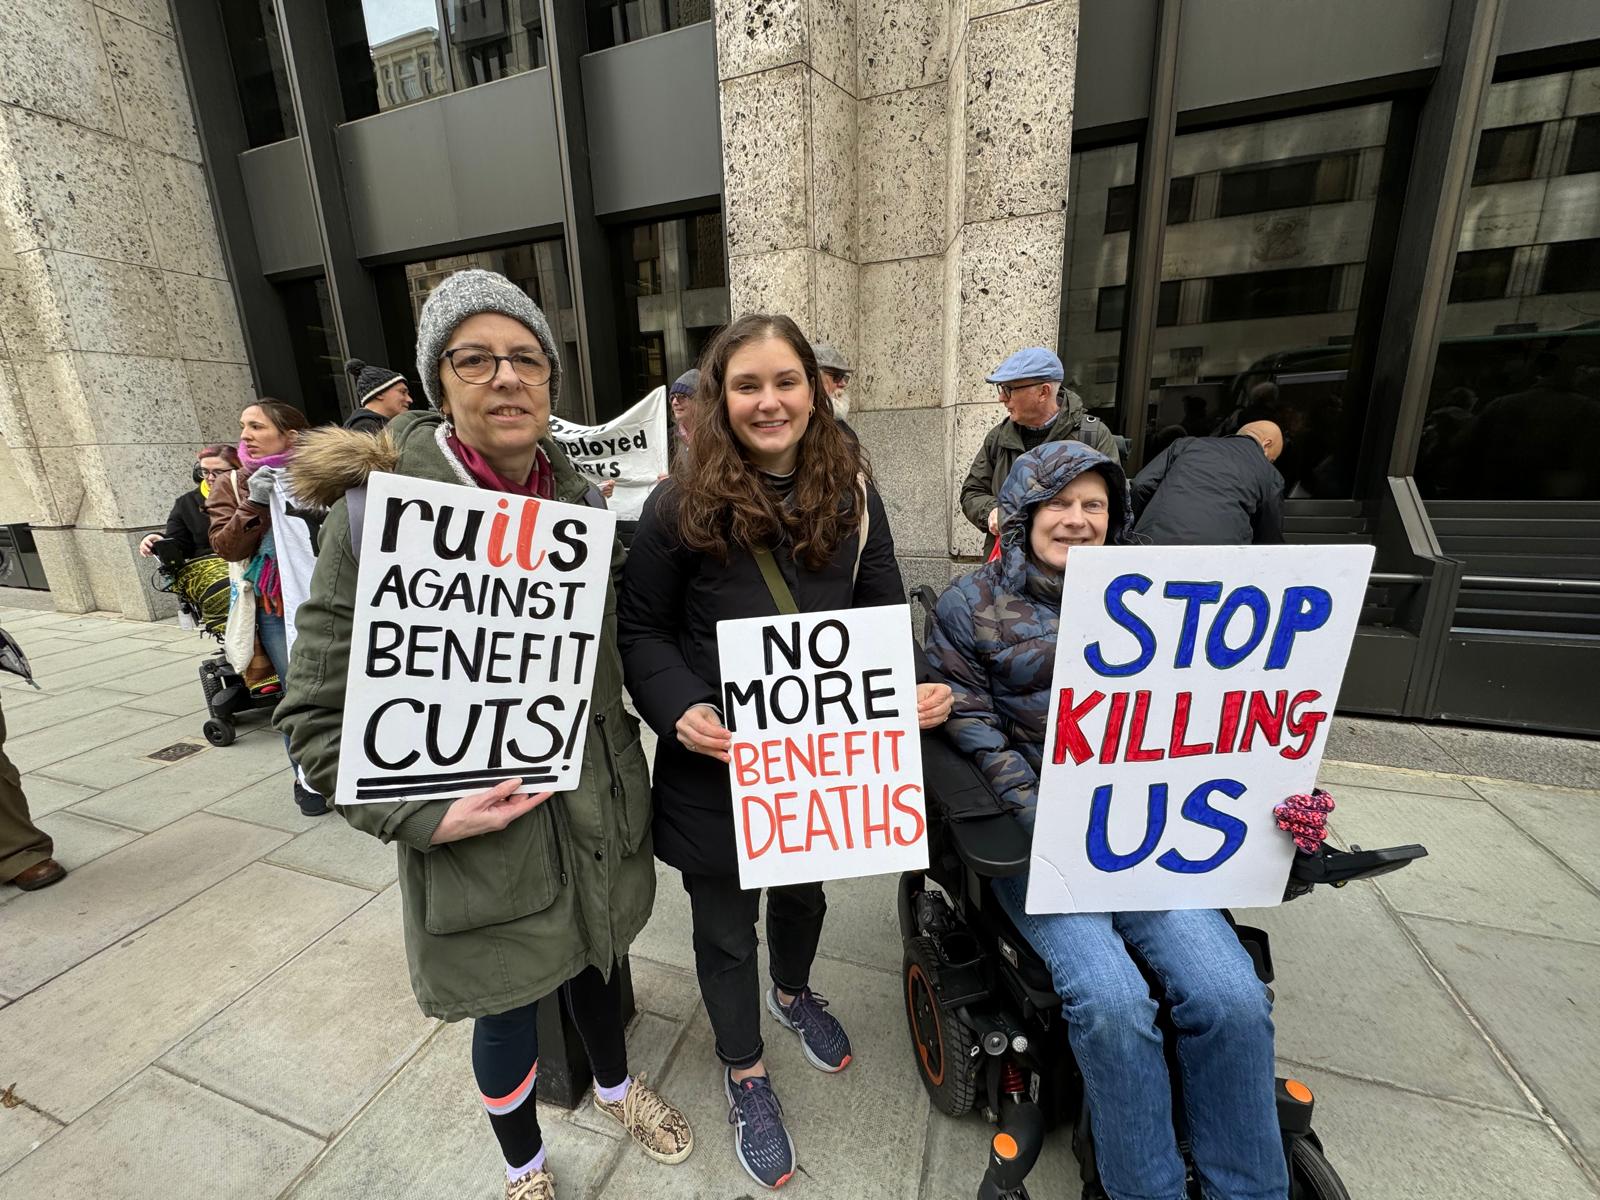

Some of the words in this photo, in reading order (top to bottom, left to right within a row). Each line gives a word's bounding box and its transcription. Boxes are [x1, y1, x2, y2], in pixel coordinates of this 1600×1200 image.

[380, 497, 588, 572] ruils
[370, 565, 586, 620] AGAINST
[1083, 573, 1333, 677] STOP
[365, 621, 595, 684] BENEFIT
[762, 619, 850, 675] NO
[363, 695, 588, 771] CUTS!
[725, 668, 899, 732] MORE
[1052, 688, 1327, 766] KILLING
[733, 730, 905, 786] BENEFIT
[742, 783, 925, 860] DEATHS
[1086, 778, 1248, 873] US
